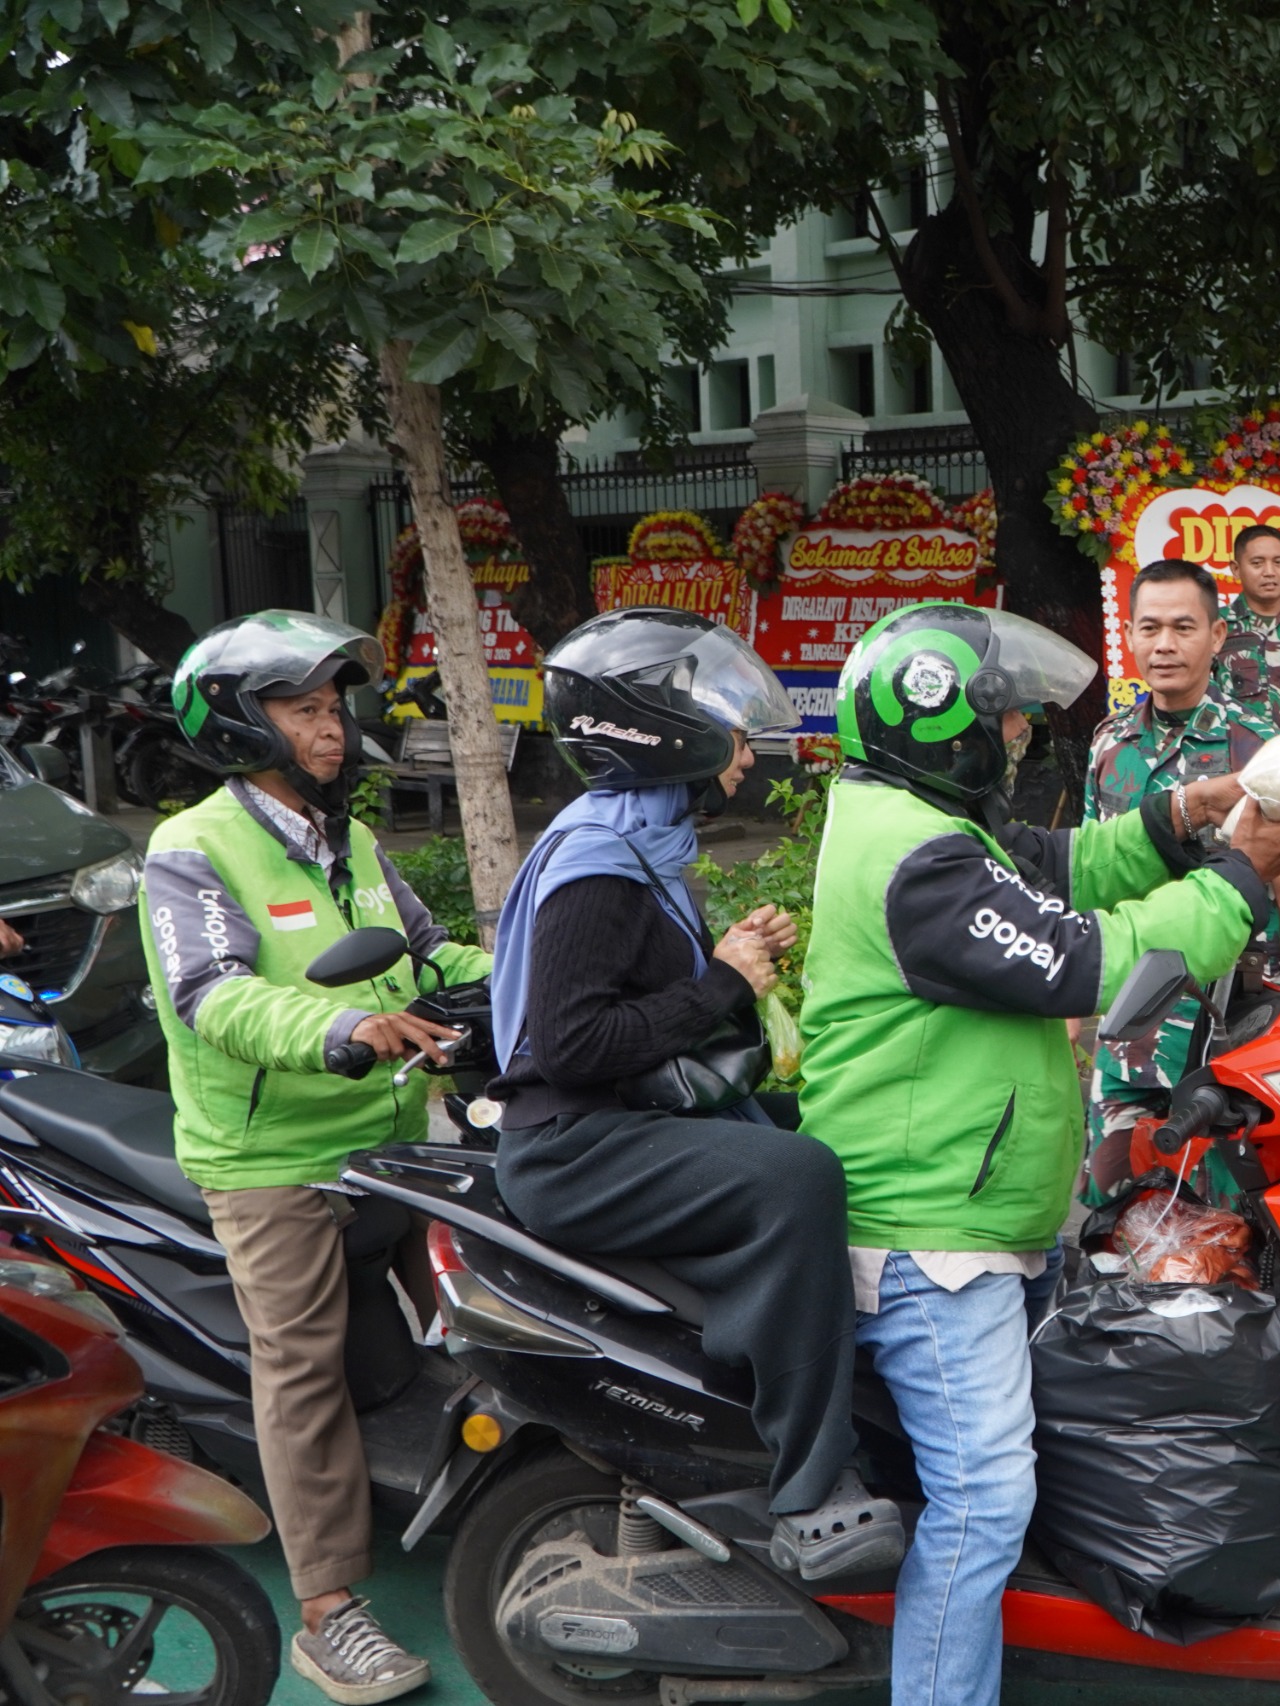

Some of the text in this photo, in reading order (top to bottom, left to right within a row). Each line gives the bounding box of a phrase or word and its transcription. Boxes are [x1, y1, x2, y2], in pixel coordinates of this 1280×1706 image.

[790, 536, 974, 567] Selamat & Sukses
[621, 580, 724, 611] DIRGAHAYU
[782, 595, 847, 621] DIRGAHAYU
[800, 643, 847, 661] TANGGAL
[968, 907, 1065, 982] gopay
[594, 1379, 705, 1432] TEMPUR
